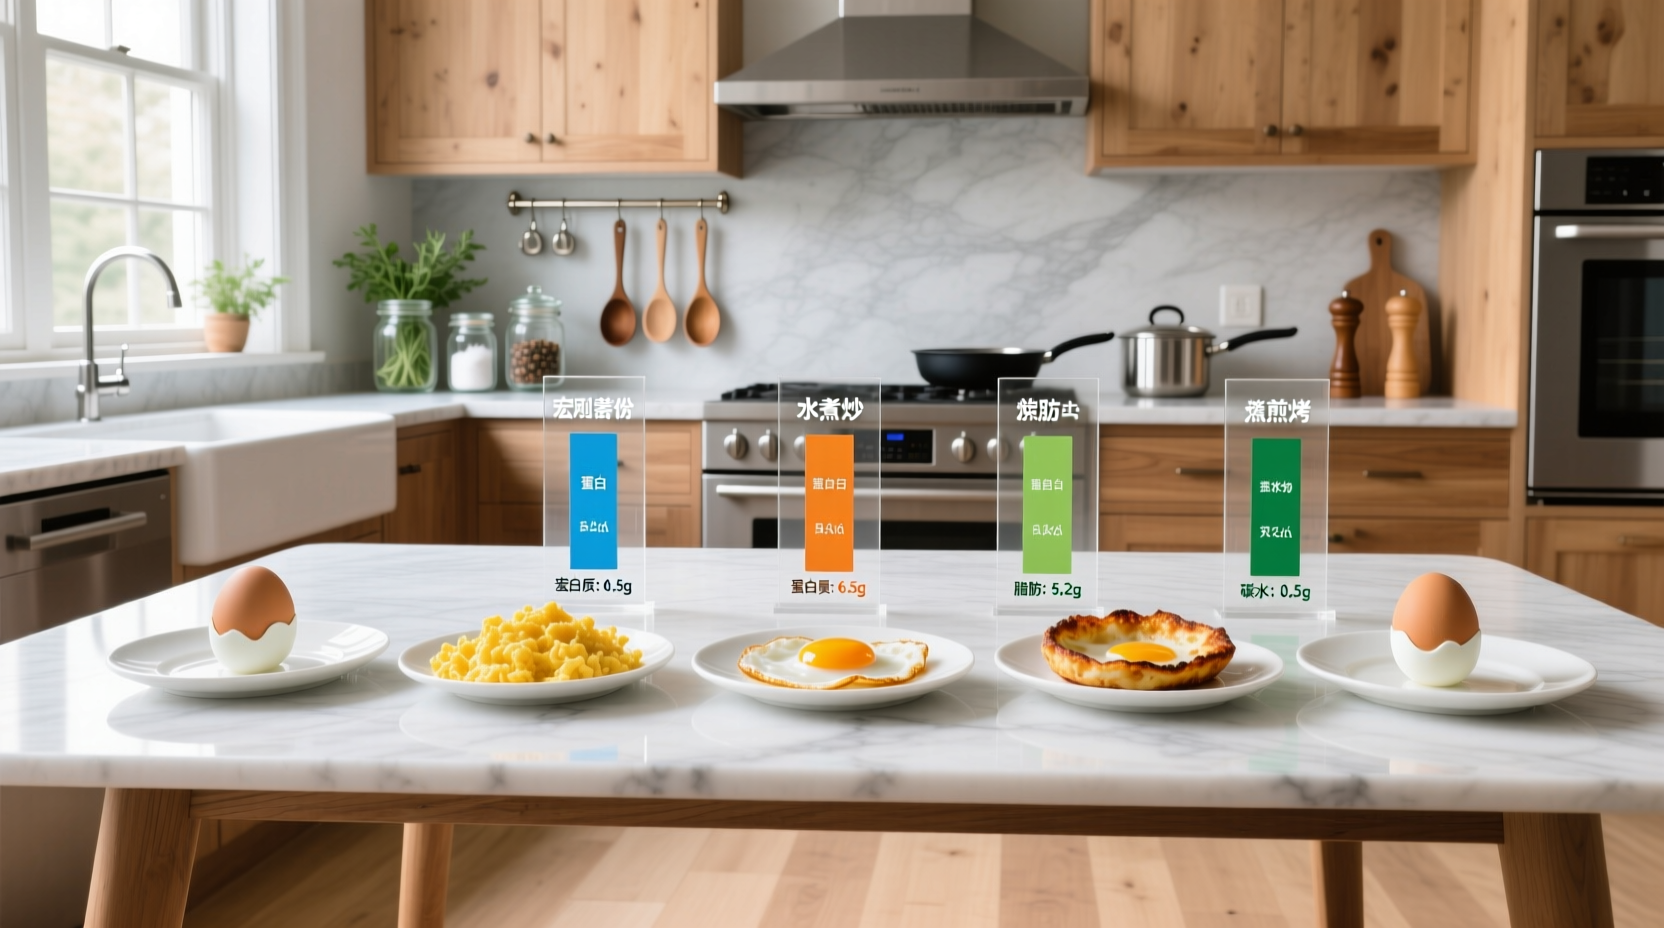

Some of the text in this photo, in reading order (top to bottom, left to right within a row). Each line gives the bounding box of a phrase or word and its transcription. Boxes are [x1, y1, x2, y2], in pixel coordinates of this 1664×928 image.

[797, 396, 864, 421] 水煮炒
[603, 579, 632, 595] 0.5g
[838, 580, 866, 597] 6.5g
[1051, 582, 1082, 599] 5.2g
[1280, 584, 1311, 601] 0.5g
